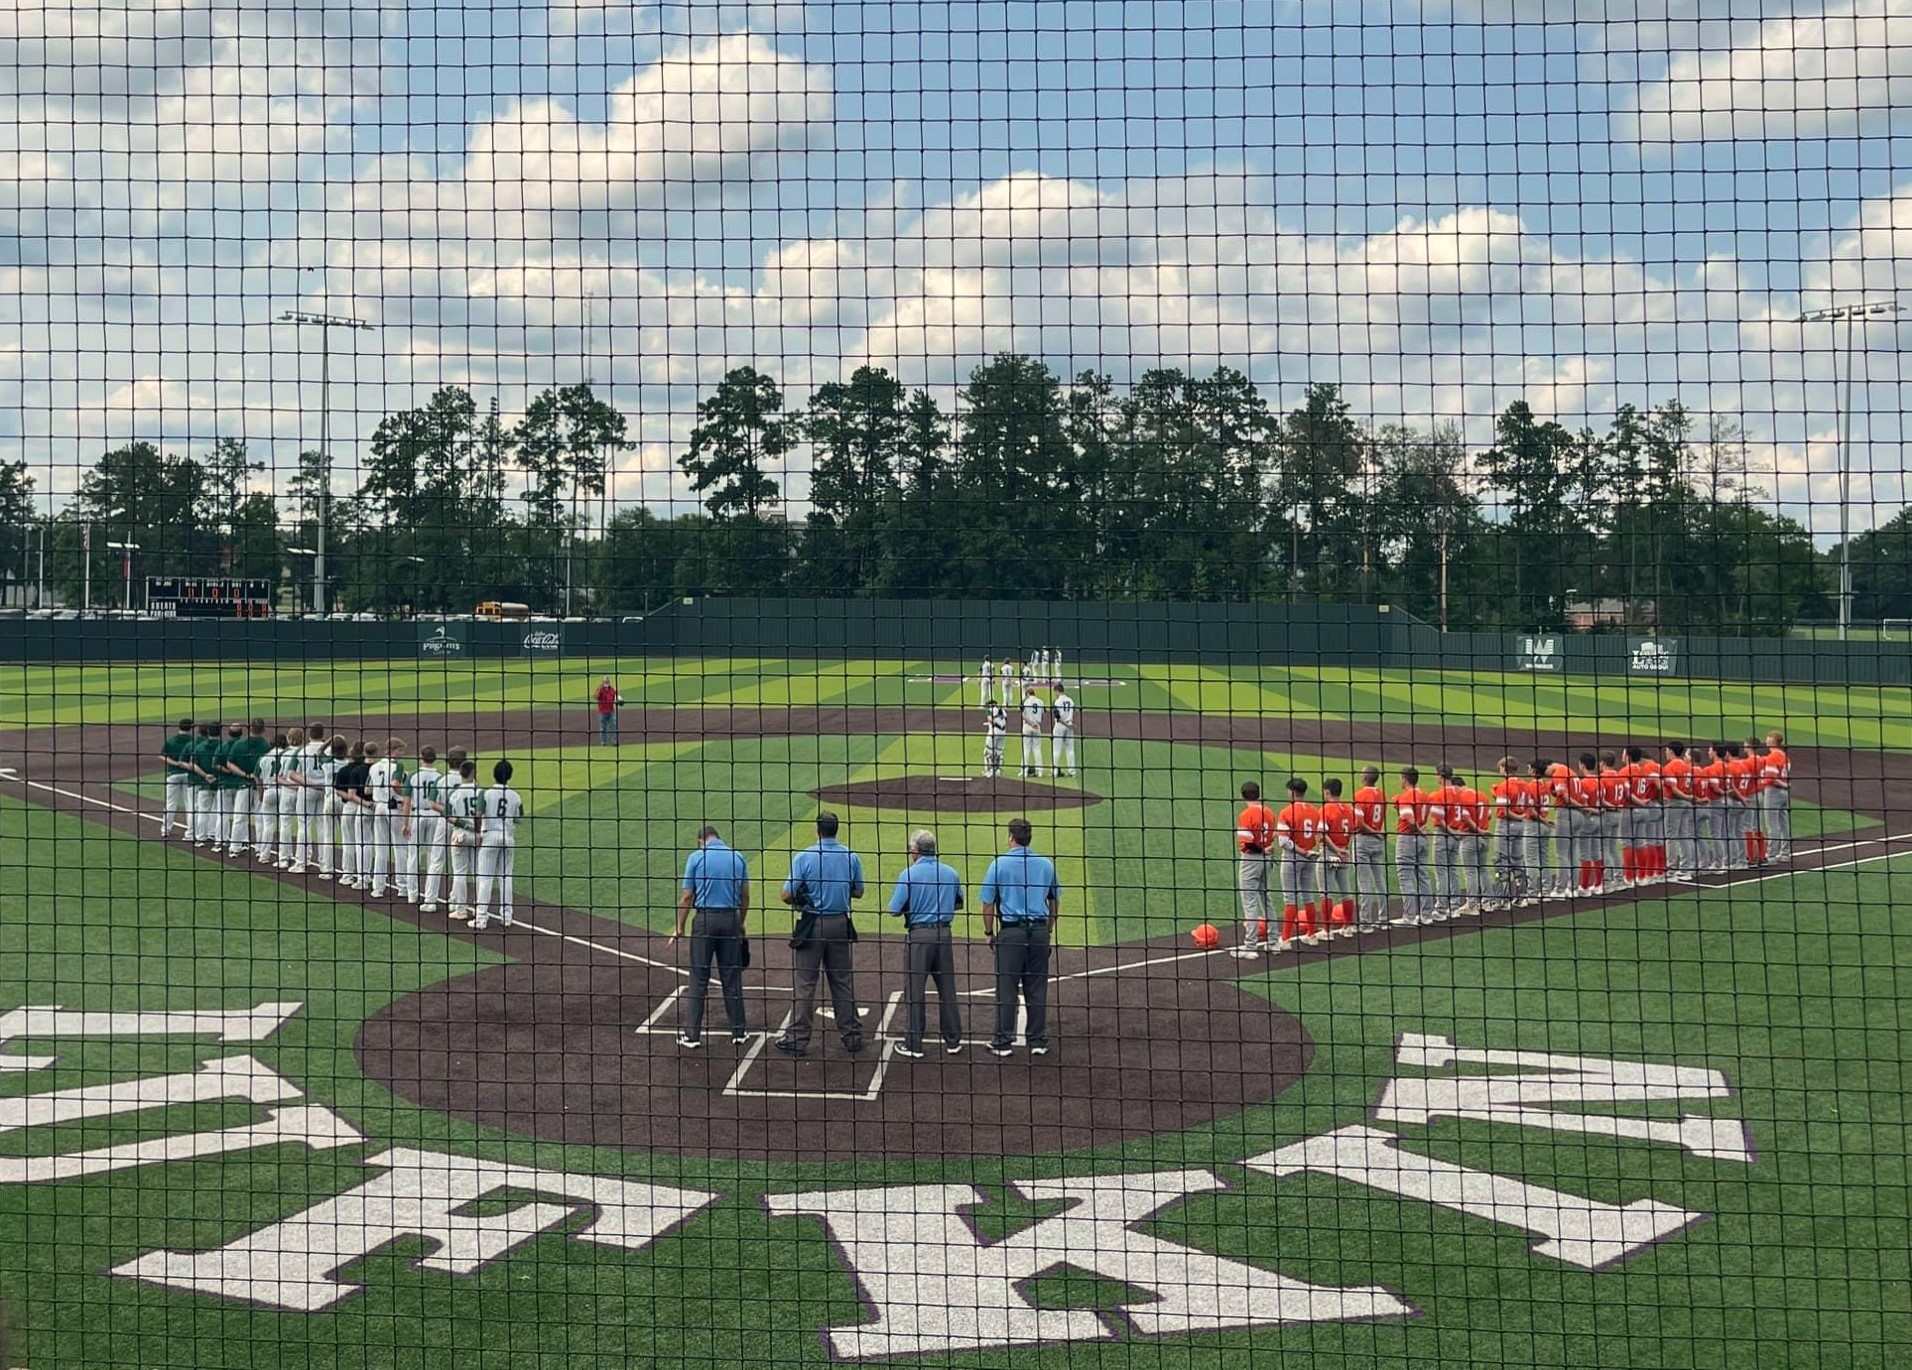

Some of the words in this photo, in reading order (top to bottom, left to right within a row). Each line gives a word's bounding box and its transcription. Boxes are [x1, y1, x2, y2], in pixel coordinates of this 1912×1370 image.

[379, 771, 385, 788] 7
[496, 798, 508, 817] 6
[1372, 804, 1381, 823] 8
[1454, 804, 1462, 822] 3
[1303, 819, 1313, 839] 6
[1341, 819, 1350, 836] 5
